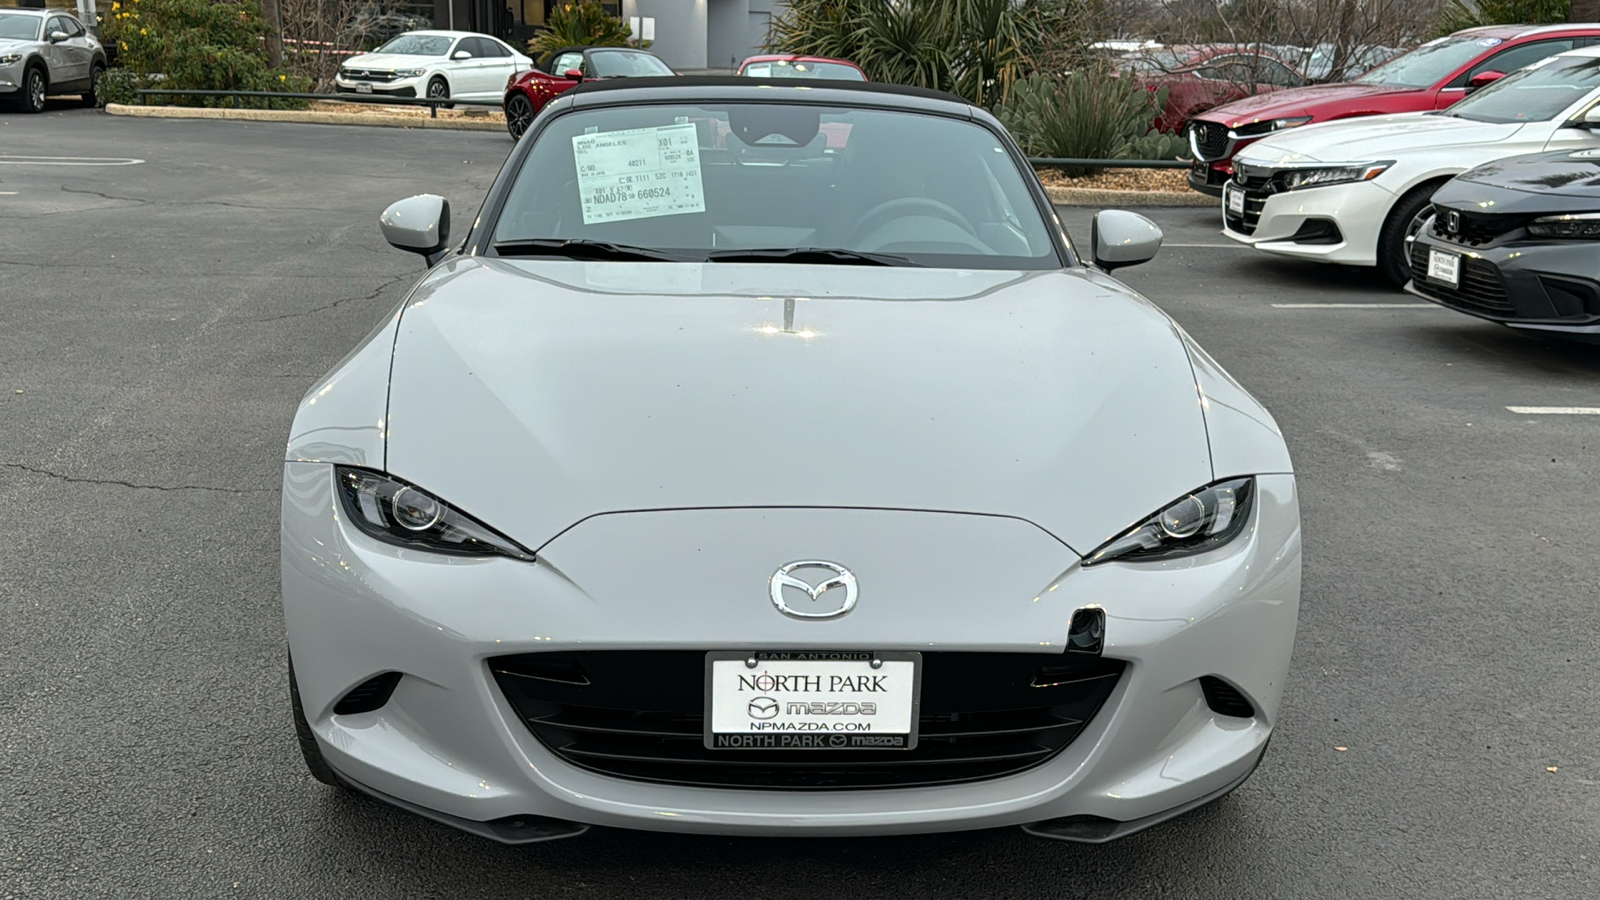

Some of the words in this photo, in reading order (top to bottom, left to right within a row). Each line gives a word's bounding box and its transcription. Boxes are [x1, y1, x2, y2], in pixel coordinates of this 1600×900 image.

[595, 140, 627, 148] ANGELES
[658, 138, 672, 147] X01
[628, 159, 646, 167] 40211
[593, 192, 627, 205] NDAD78
[638, 187, 670, 199] 660524
[738, 675, 821, 692] NORTH
[829, 675, 888, 692] PARK
[787, 702, 876, 715] mazda
[750, 722, 871, 731] NPMAZDA.COM
[718, 735, 774, 747] NORTH
[781, 735, 824, 747] PARK
